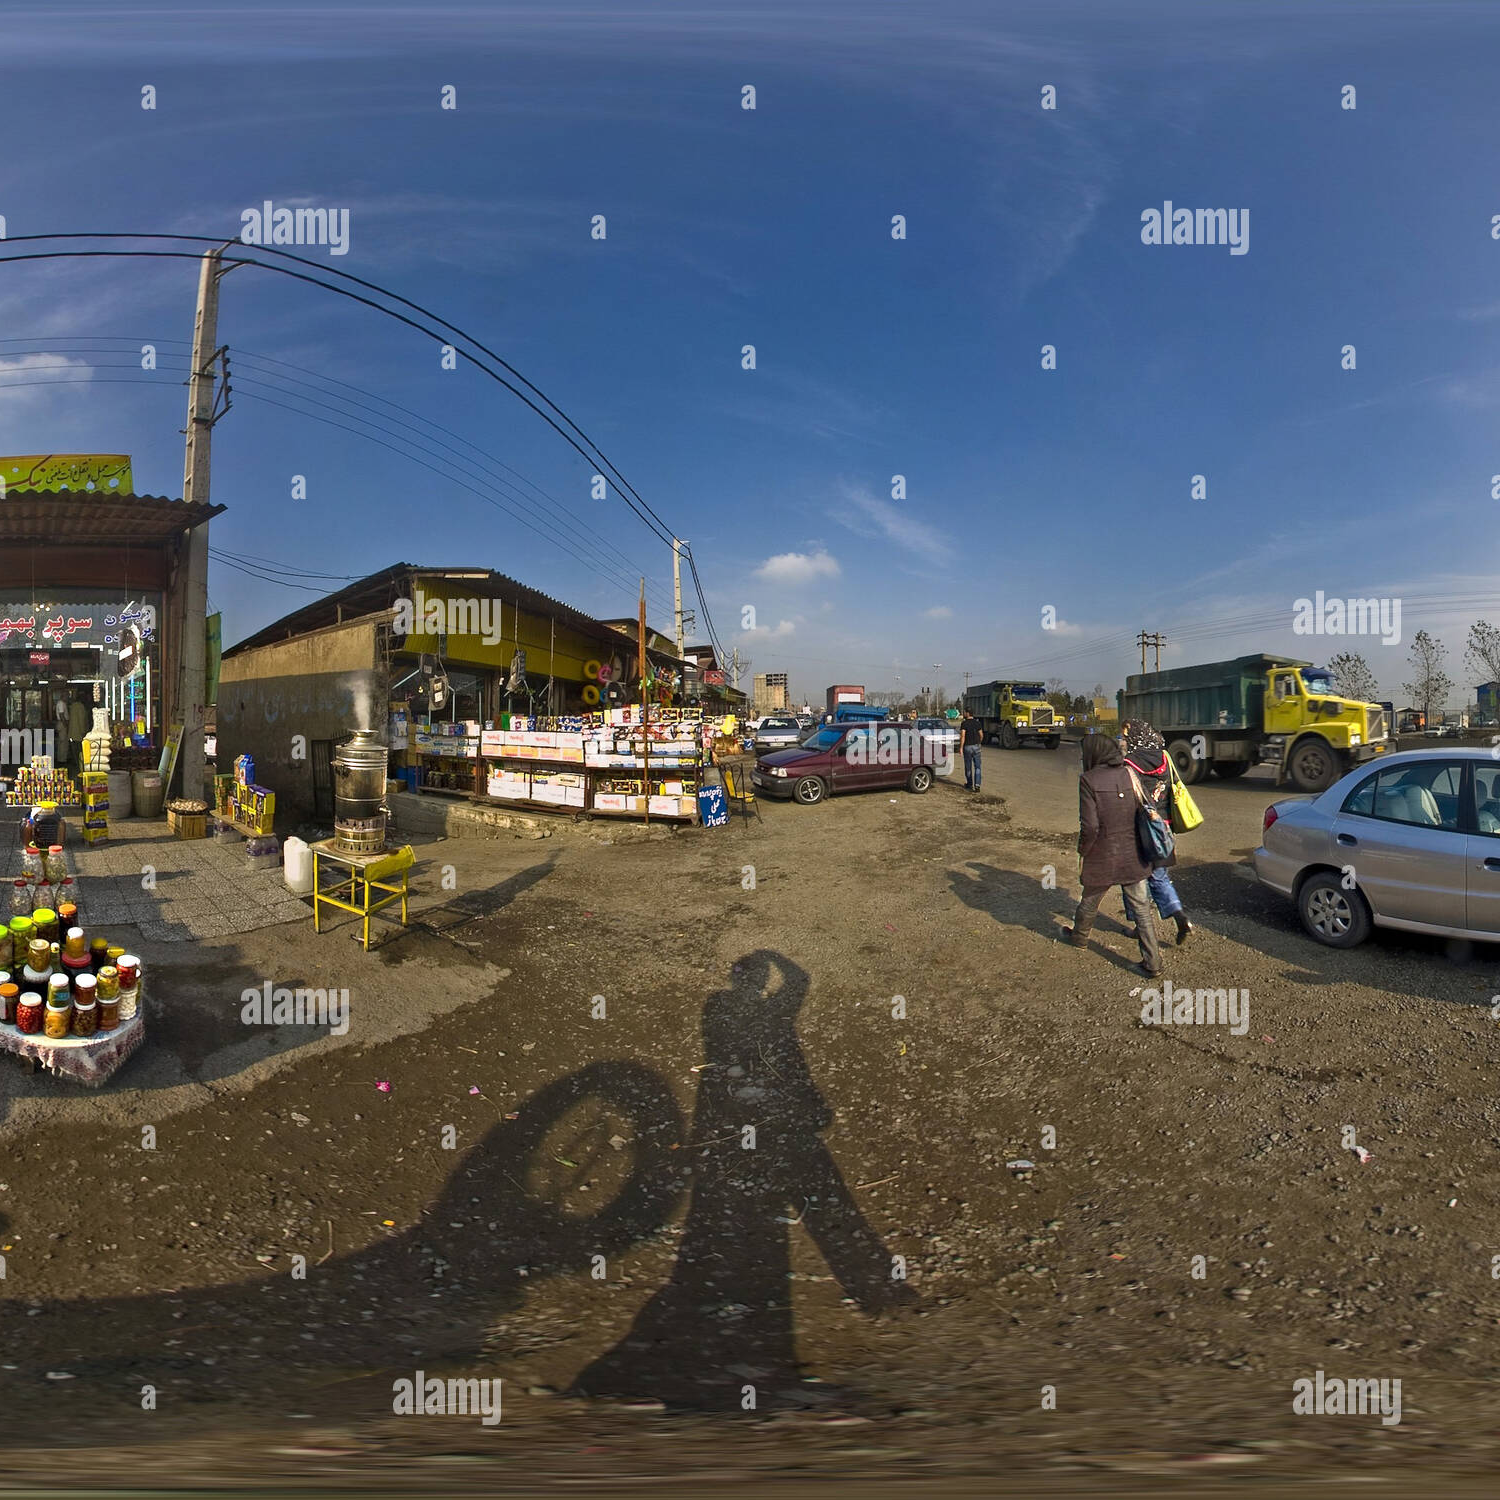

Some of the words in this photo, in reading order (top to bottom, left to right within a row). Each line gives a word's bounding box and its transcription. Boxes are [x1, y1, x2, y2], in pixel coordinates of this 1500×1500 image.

[0, 615, 36, 640] بهم
[43, 614, 93, 643] سوپر
[104, 606, 151, 628] زیتون
[104, 625, 156, 643] پرده
